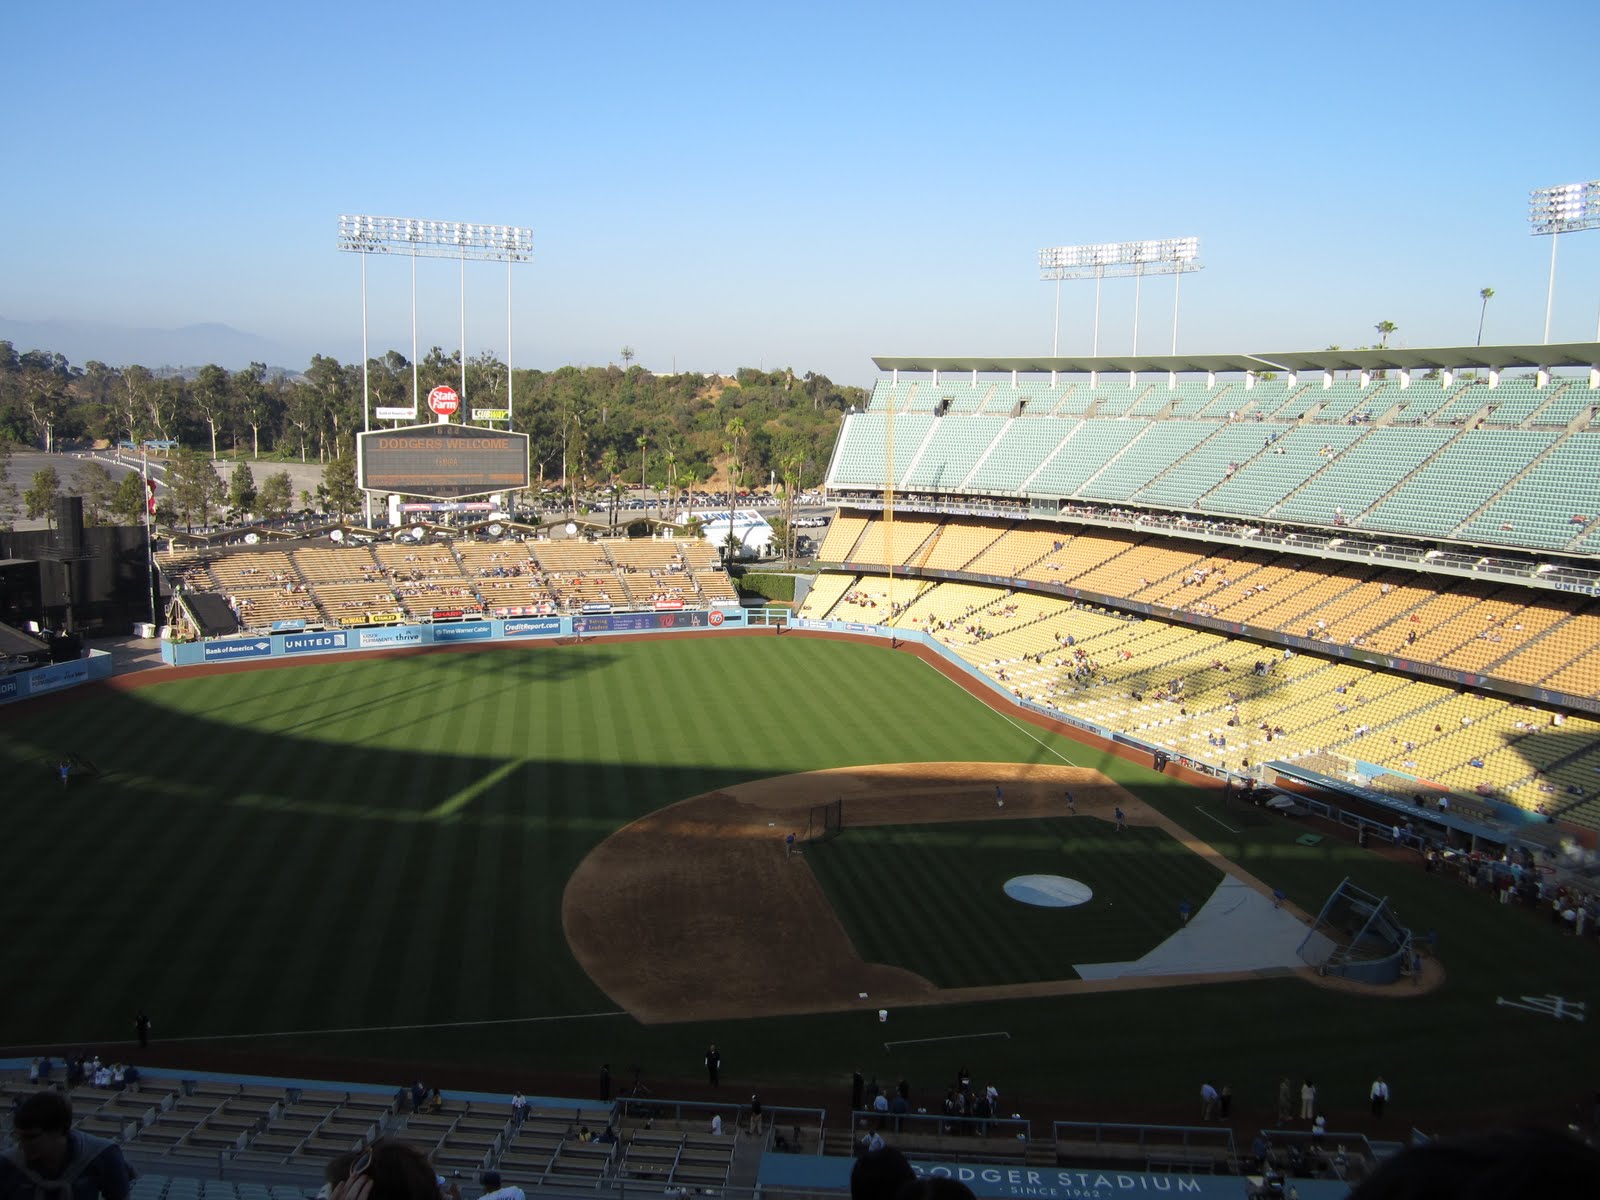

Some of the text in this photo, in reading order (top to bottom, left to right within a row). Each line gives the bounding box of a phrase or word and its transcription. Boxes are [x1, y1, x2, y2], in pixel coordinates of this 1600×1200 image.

[433, 391, 458, 400] State
[433, 401, 457, 409] Farm
[476, 410, 507, 418] SUBWAY
[379, 438, 509, 449] DODGERS WELCOME
[1555, 582, 1600, 595] UNITED
[374, 614, 396, 622] STANLEY
[711, 613, 722, 623] 76
[505, 622, 559, 632] CreditReport.com
[396, 632, 419, 642] thrive
[286, 638, 331, 648] UNITED
[1298, 639, 1330, 653] DODGERS
[206, 647, 221, 655] Bank
[229, 645, 254, 653] America
[1413, 663, 1458, 681] NATIONALS
[1058, 1172, 1202, 1192] STADIUM
[1011, 1186, 1101, 1198] SINCE 1962
